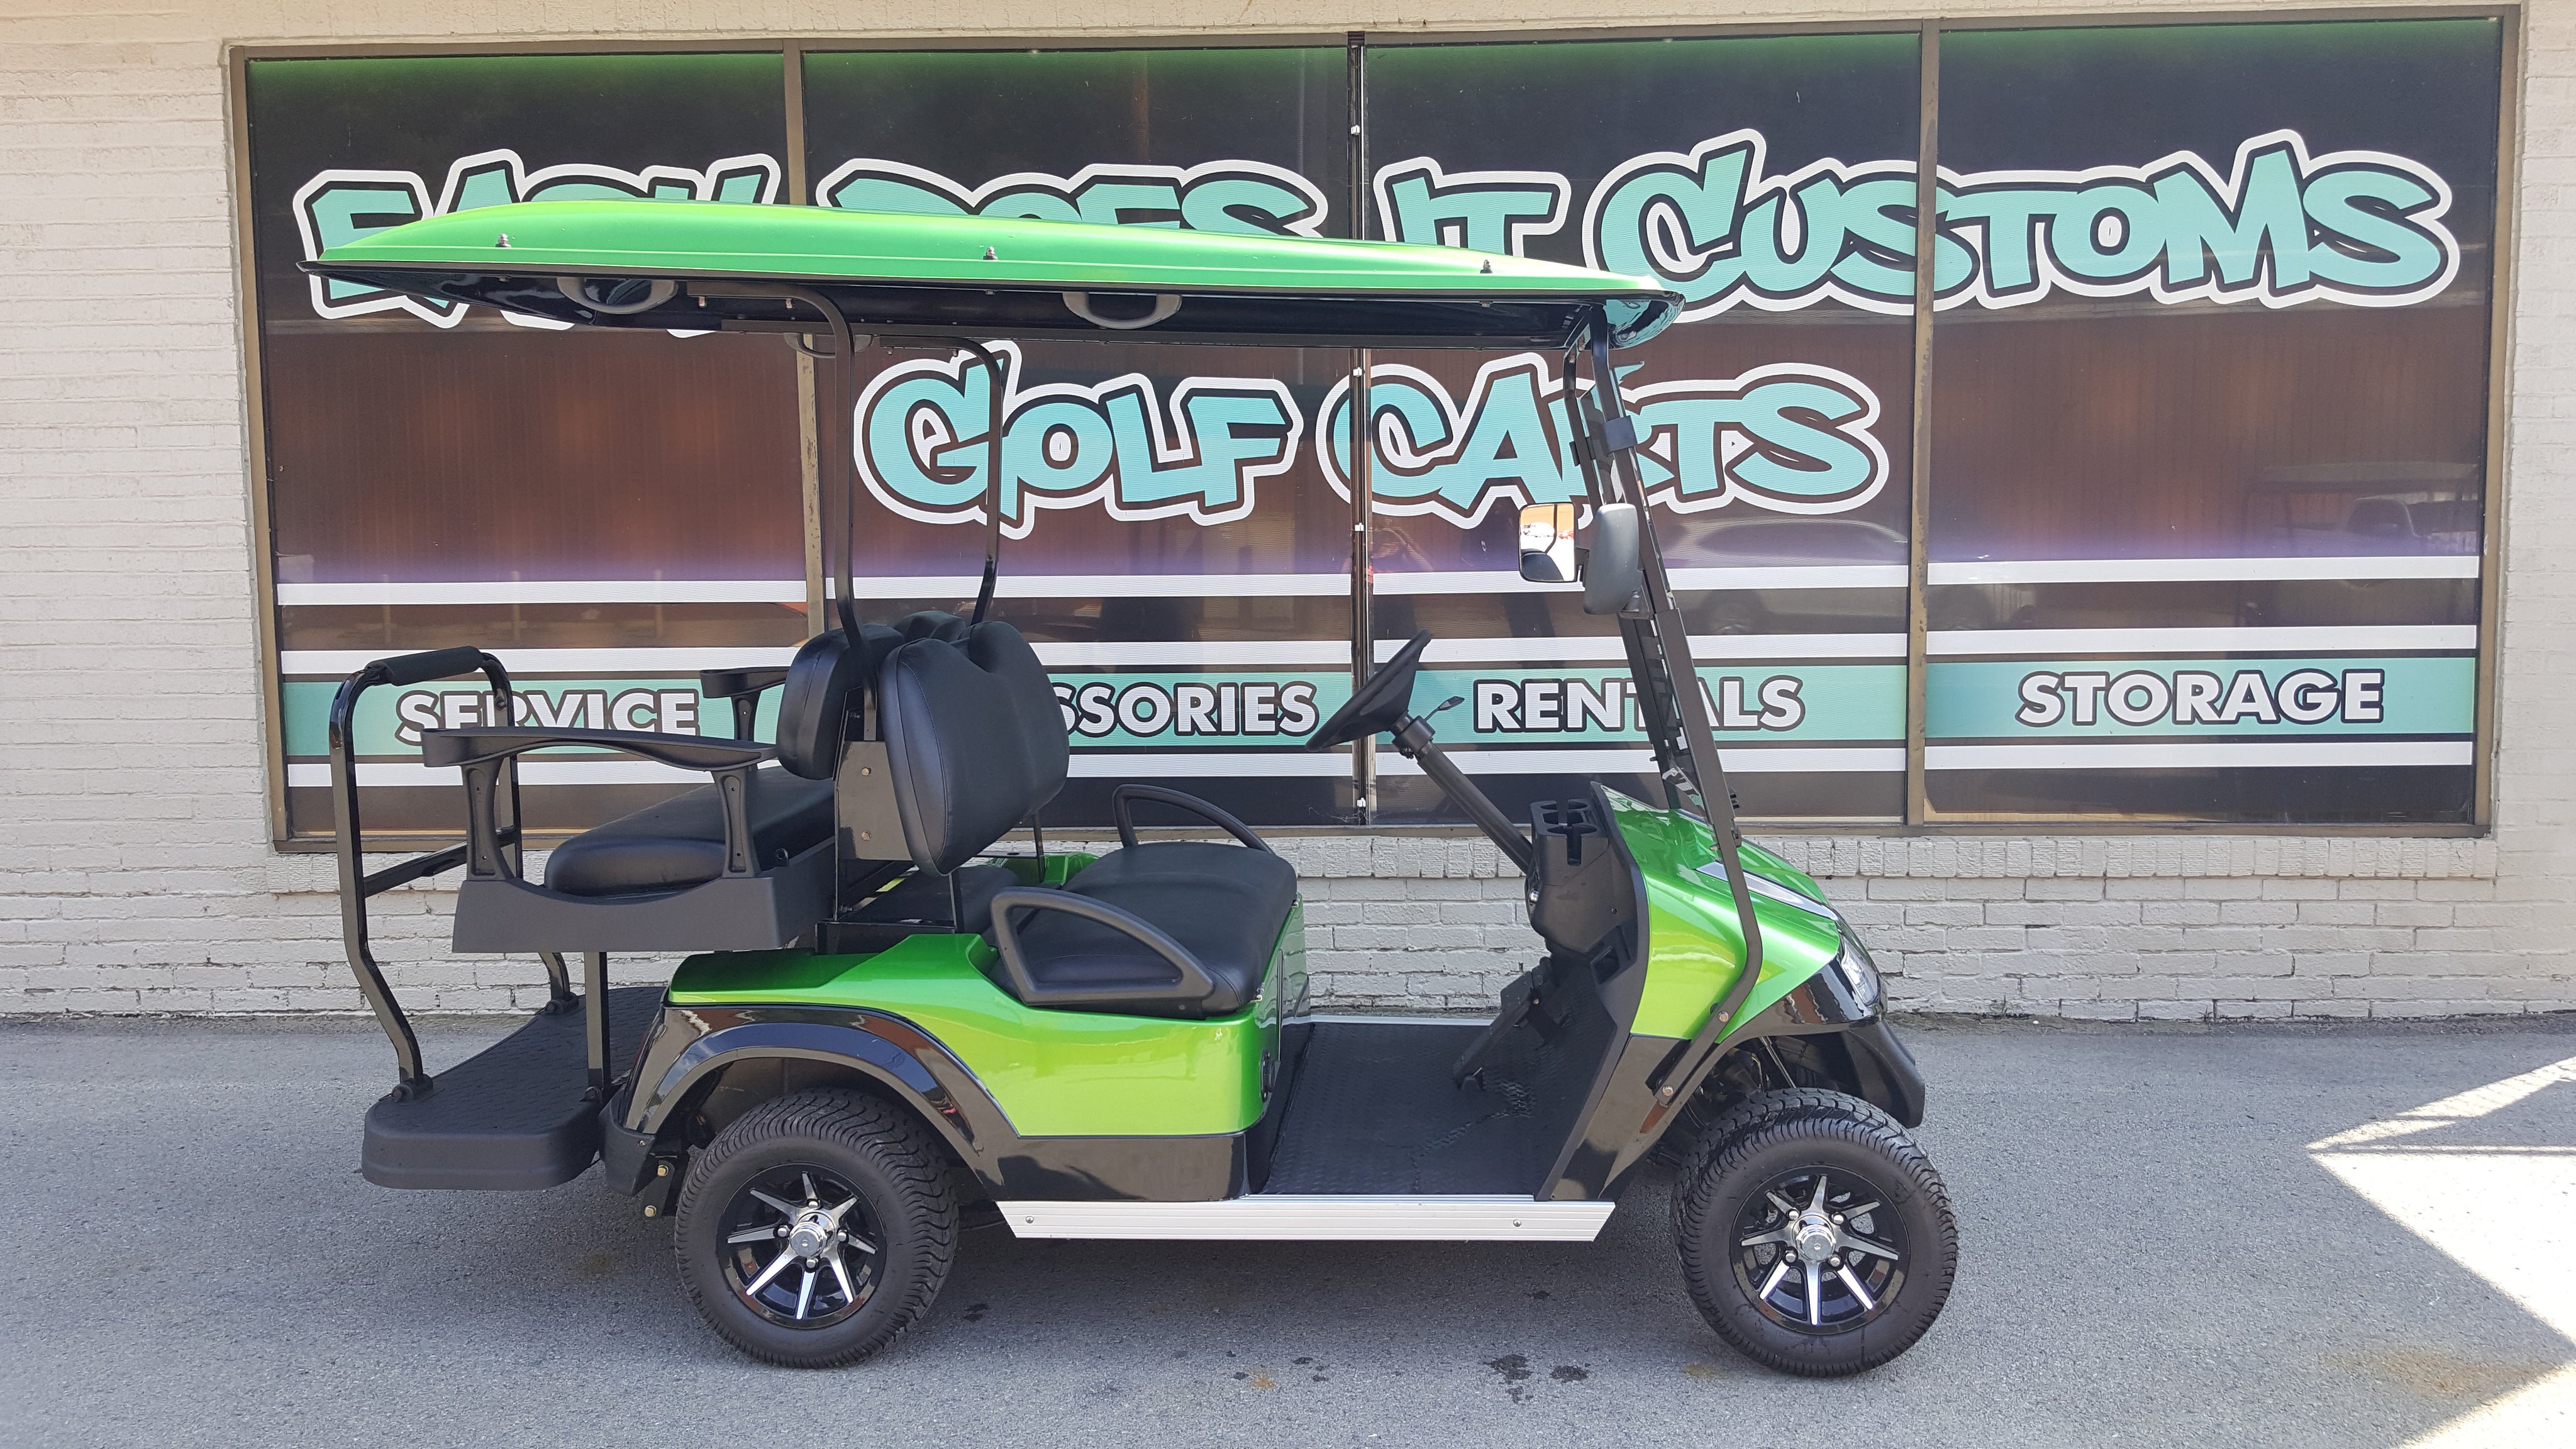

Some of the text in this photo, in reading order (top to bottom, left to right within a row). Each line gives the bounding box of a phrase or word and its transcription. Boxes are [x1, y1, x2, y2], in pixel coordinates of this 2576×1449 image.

[1590, 137, 2451, 312] CUSTOMS
[860, 348, 1294, 527] GOLF
[1052, 681, 1319, 737] SORIES
[2014, 669, 2384, 727] STORAGE
